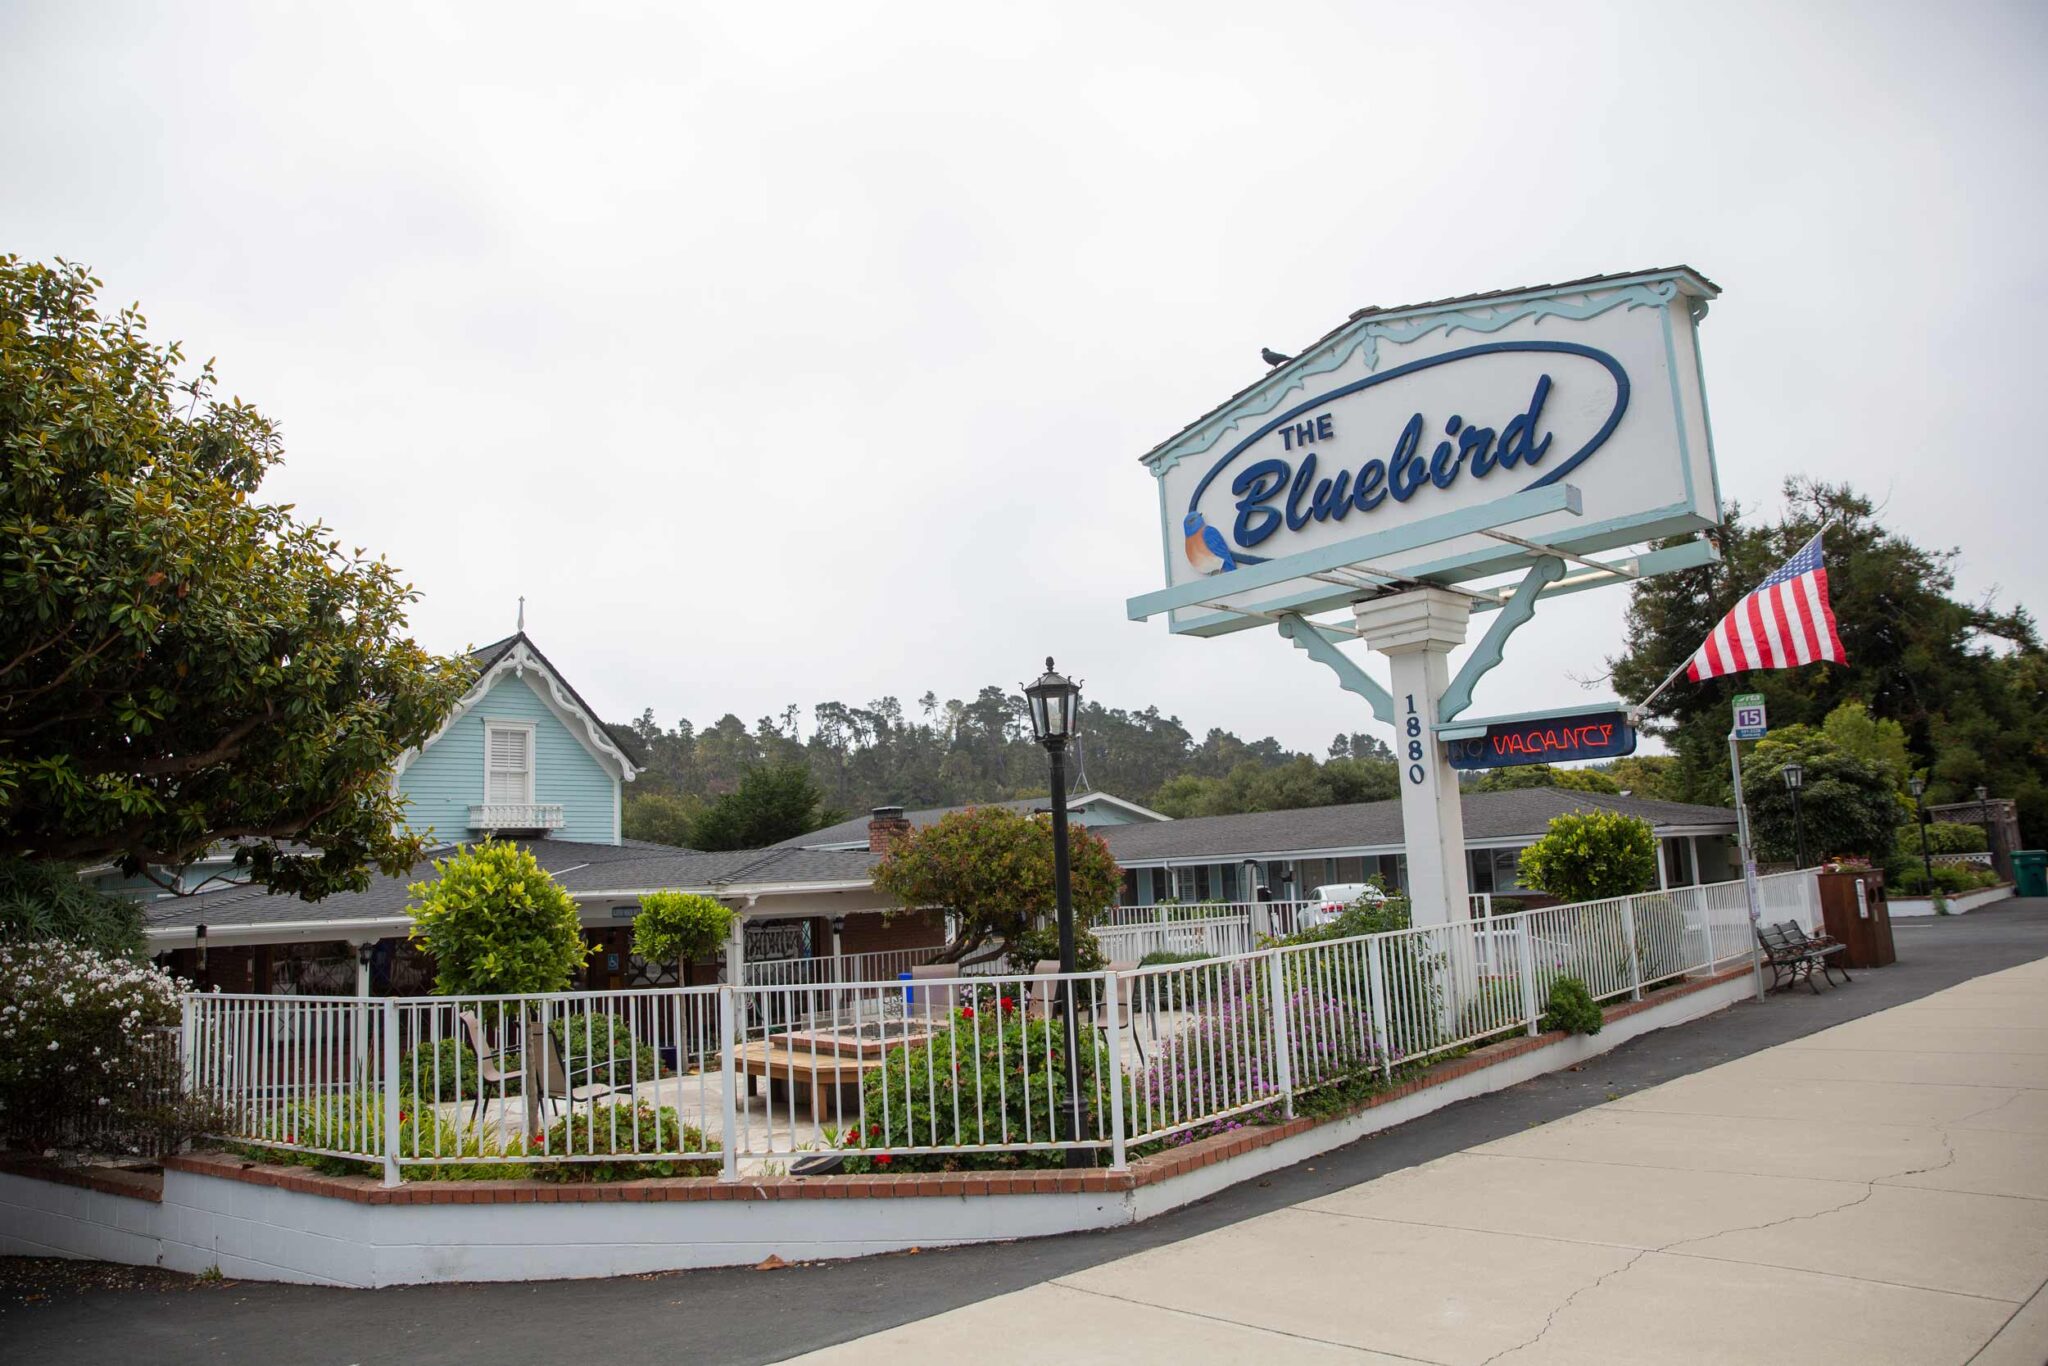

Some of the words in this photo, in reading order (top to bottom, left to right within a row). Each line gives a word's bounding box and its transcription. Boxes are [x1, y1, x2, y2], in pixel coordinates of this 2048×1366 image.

[1278, 413, 1333, 451] THE
[1232, 374, 1552, 547] Bluebird
[1740, 710, 1760, 725] 15
[1405, 694, 1424, 784] 1880
[1492, 724, 1613, 755] VACANCY
